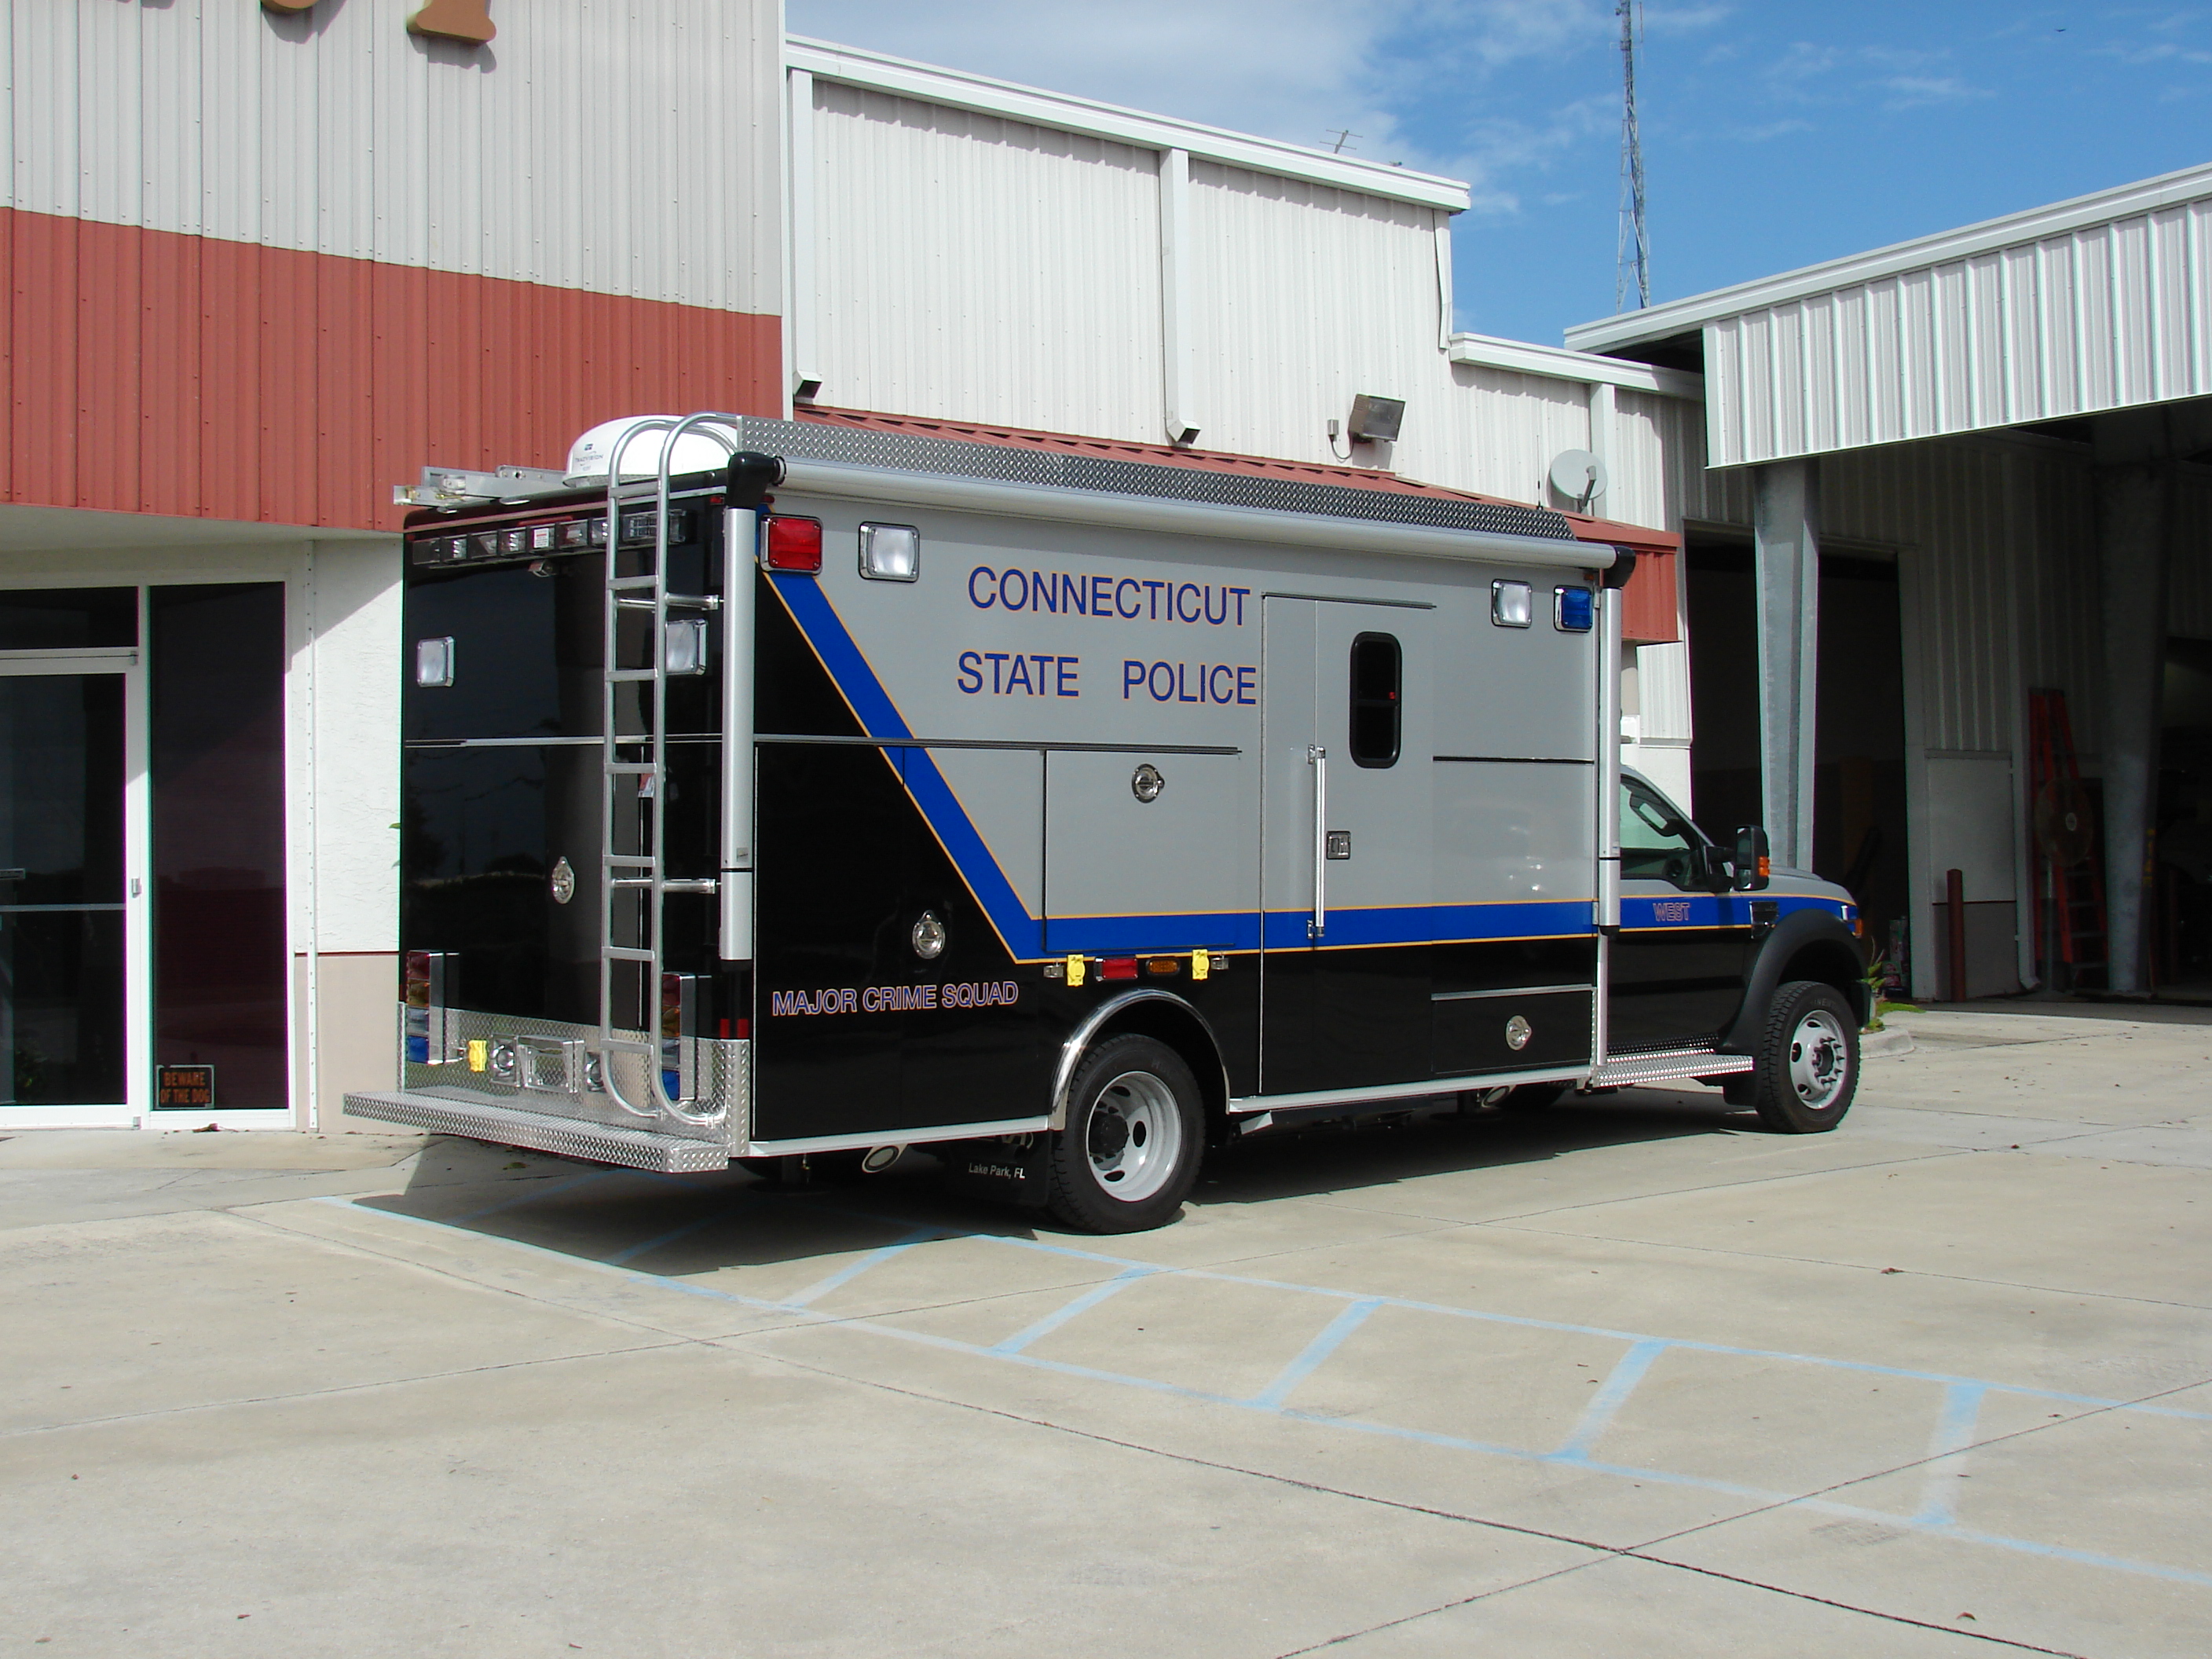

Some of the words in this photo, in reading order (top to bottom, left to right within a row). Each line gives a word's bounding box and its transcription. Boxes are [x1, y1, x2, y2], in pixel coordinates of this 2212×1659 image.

[967, 564, 1252, 627] CONNECTICUT
[956, 649, 1080, 698] STATE
[1122, 658, 1257, 706] POLICE
[1653, 902, 1690, 921] WEST
[772, 988, 858, 1016] MAJOR
[862, 984, 937, 1012] CRIME
[942, 981, 1019, 1008] SQUAD
[163, 1071, 206, 1087] BEWARE
[159, 1088, 171, 1104] OF
[173, 1088, 190, 1104] THE
[191, 1088, 211, 1104] DOG
[968, 1163, 989, 1174] Lake
[990, 1165, 1012, 1179] Park,
[1013, 1167, 1026, 1180] FL
